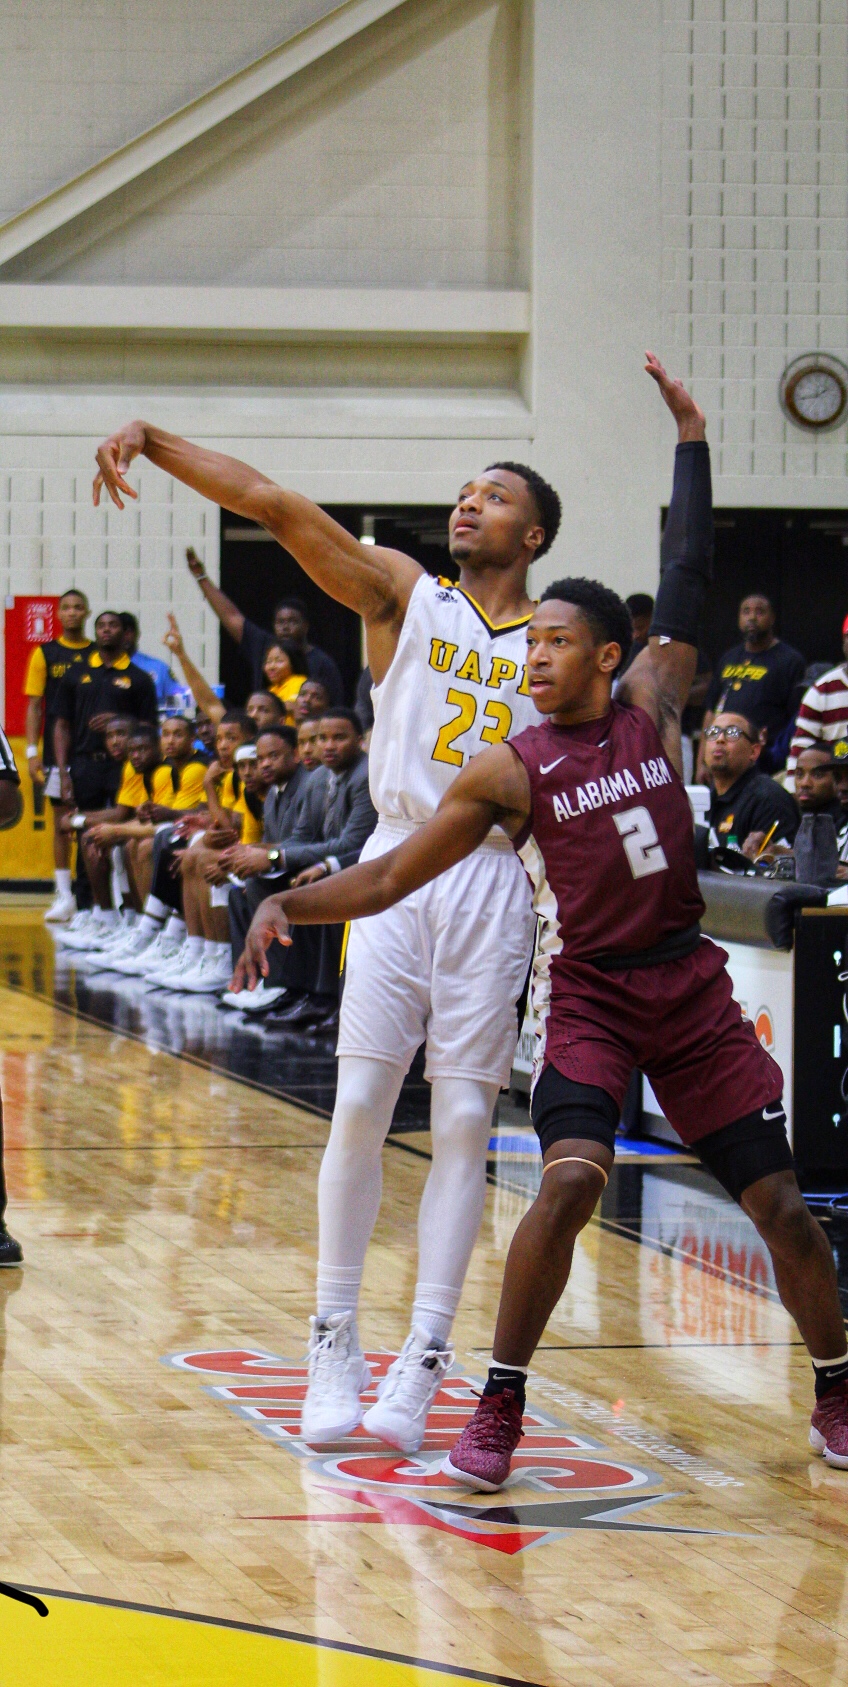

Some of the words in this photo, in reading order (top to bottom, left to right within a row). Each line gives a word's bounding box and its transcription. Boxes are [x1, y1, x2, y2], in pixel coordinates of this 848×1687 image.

[431, 687, 513, 767] 23
[552, 768, 641, 823] ALABAMA
[640, 756, 672, 789] A&M
[612, 805, 669, 880] 2
